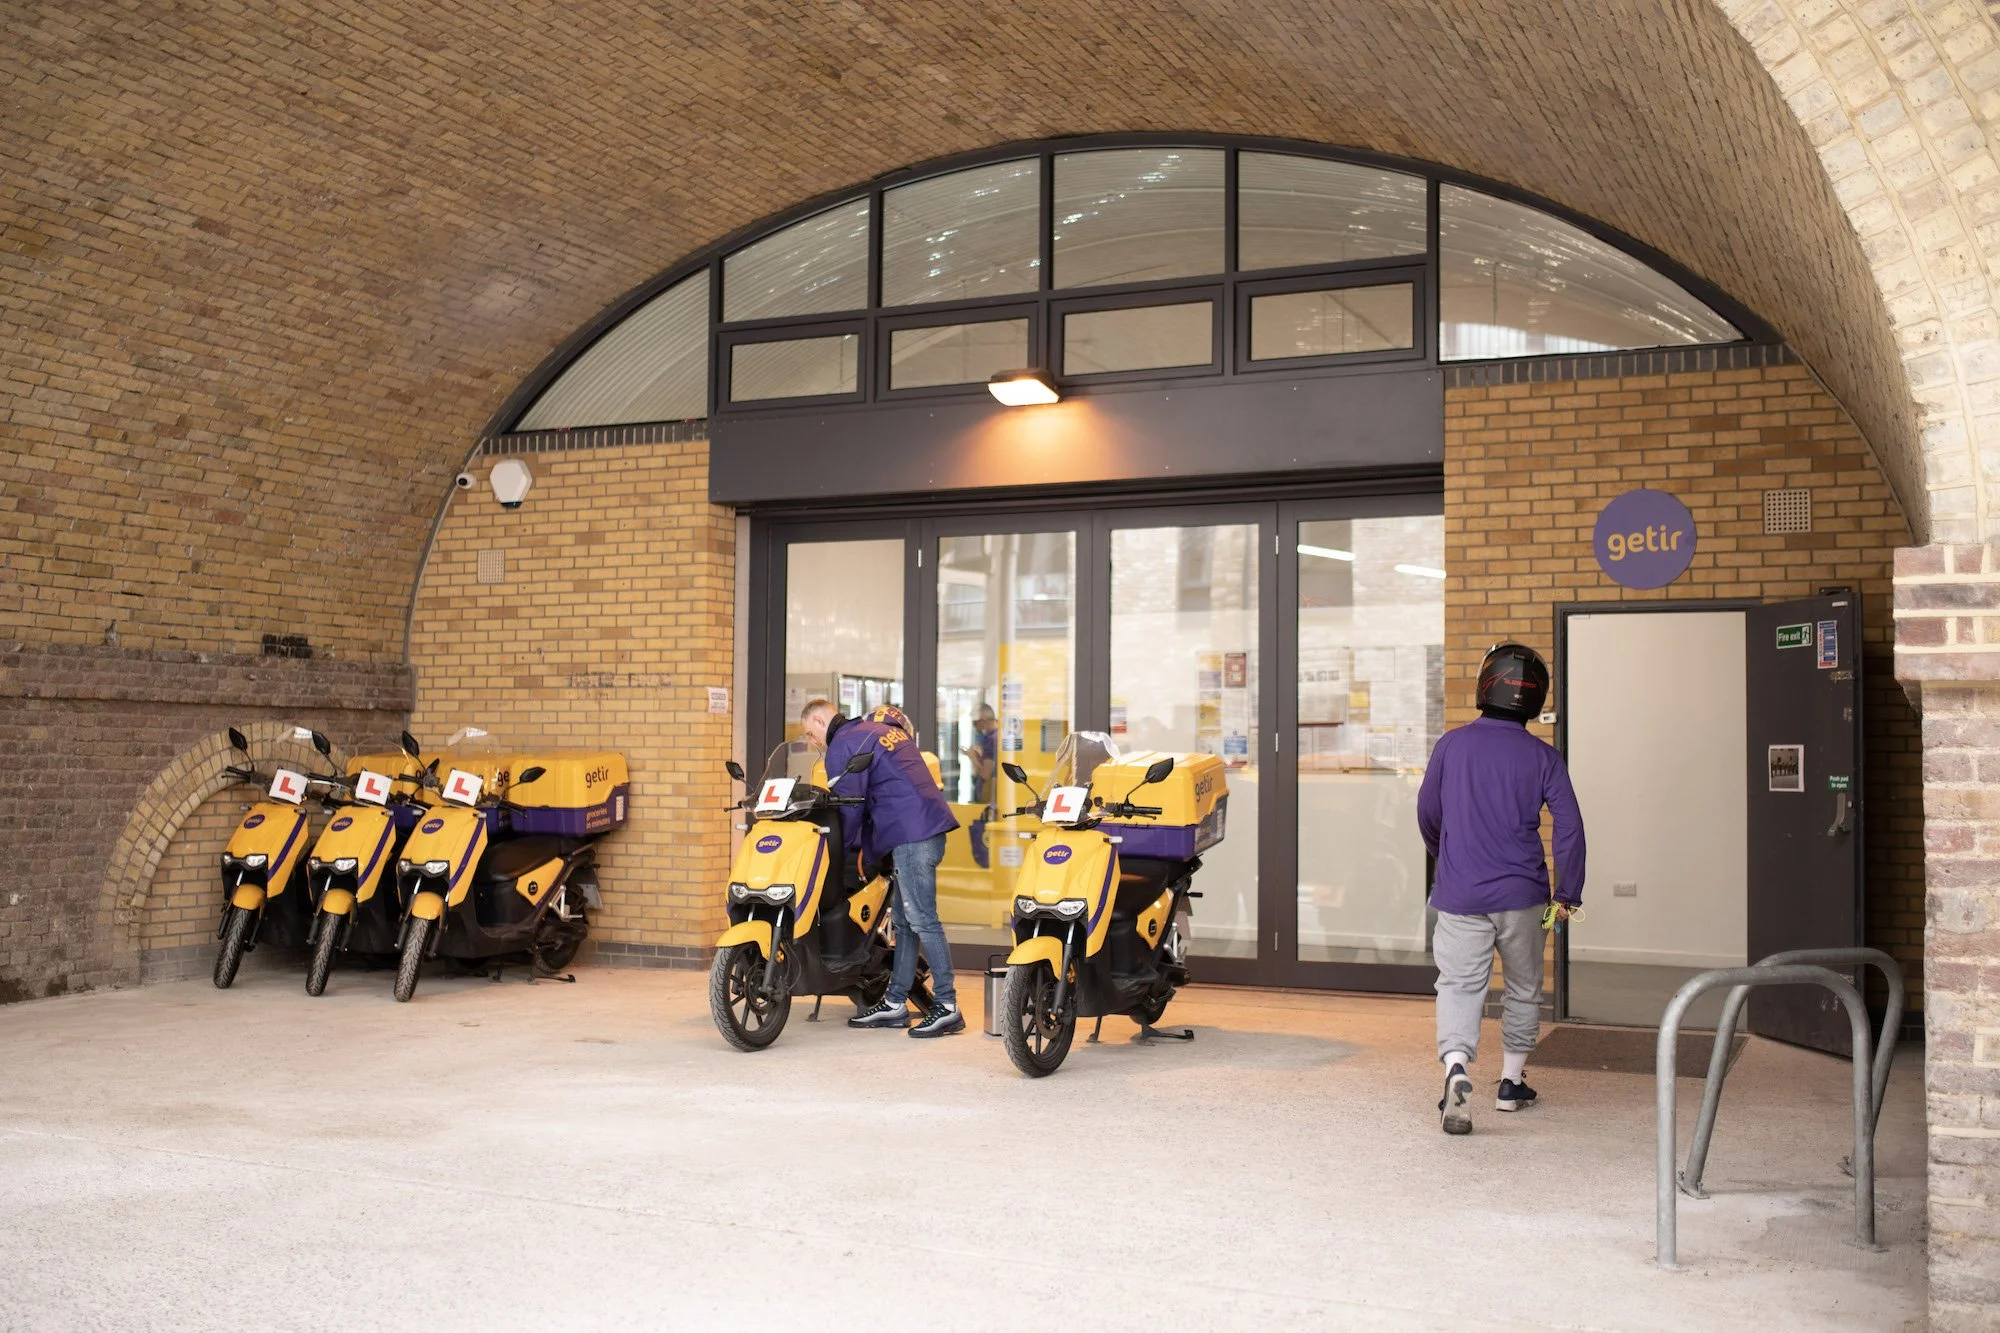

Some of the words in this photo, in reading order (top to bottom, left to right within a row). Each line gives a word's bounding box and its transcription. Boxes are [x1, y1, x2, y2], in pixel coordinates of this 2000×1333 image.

[1607, 524, 1683, 562] getir
[1779, 632, 1789, 642] Fire
[1790, 631, 1801, 642] exit
[279, 776, 296, 796] L
[364, 777, 381, 796] L
[453, 777, 470, 796] L
[585, 766, 609, 788] getir
[764, 785, 780, 803] L
[1194, 775, 1213, 802] getir
[1052, 794, 1071, 813] L
[758, 839, 780, 848] getir
[1046, 849, 1069, 858] getir
